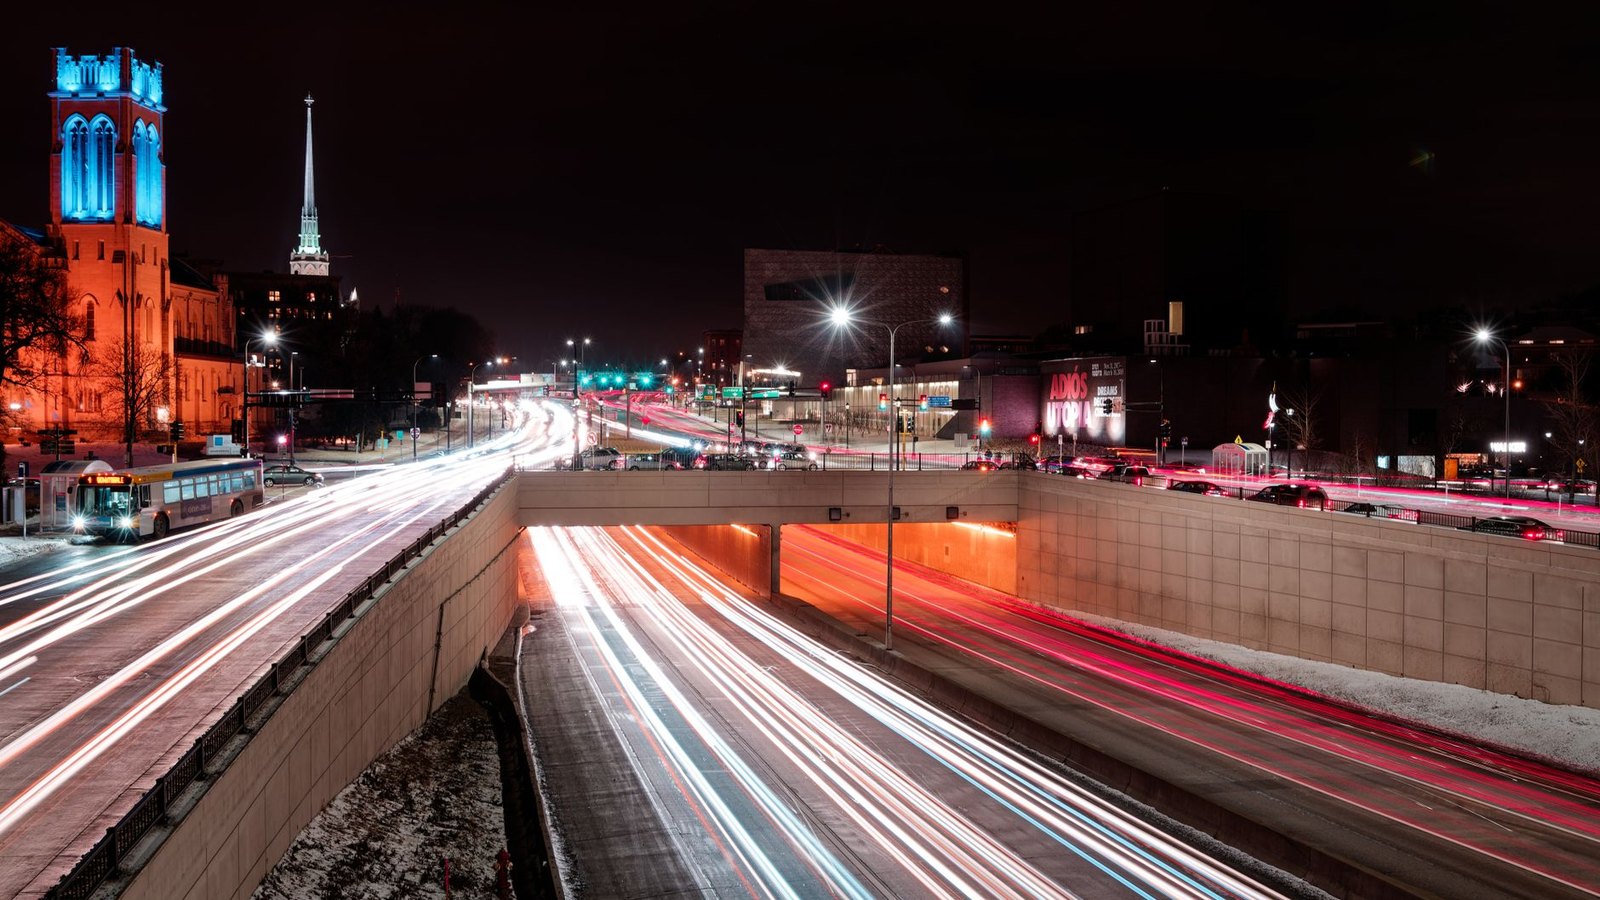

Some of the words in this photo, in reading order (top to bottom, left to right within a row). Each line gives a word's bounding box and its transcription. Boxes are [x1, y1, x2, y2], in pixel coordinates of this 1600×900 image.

[1050, 366, 1088, 400] ADIÓS
[1097, 386, 1118, 396] DREAMS
[1047, 401, 1093, 428] UTOPIA
[1490, 442, 1526, 452] WALKER
